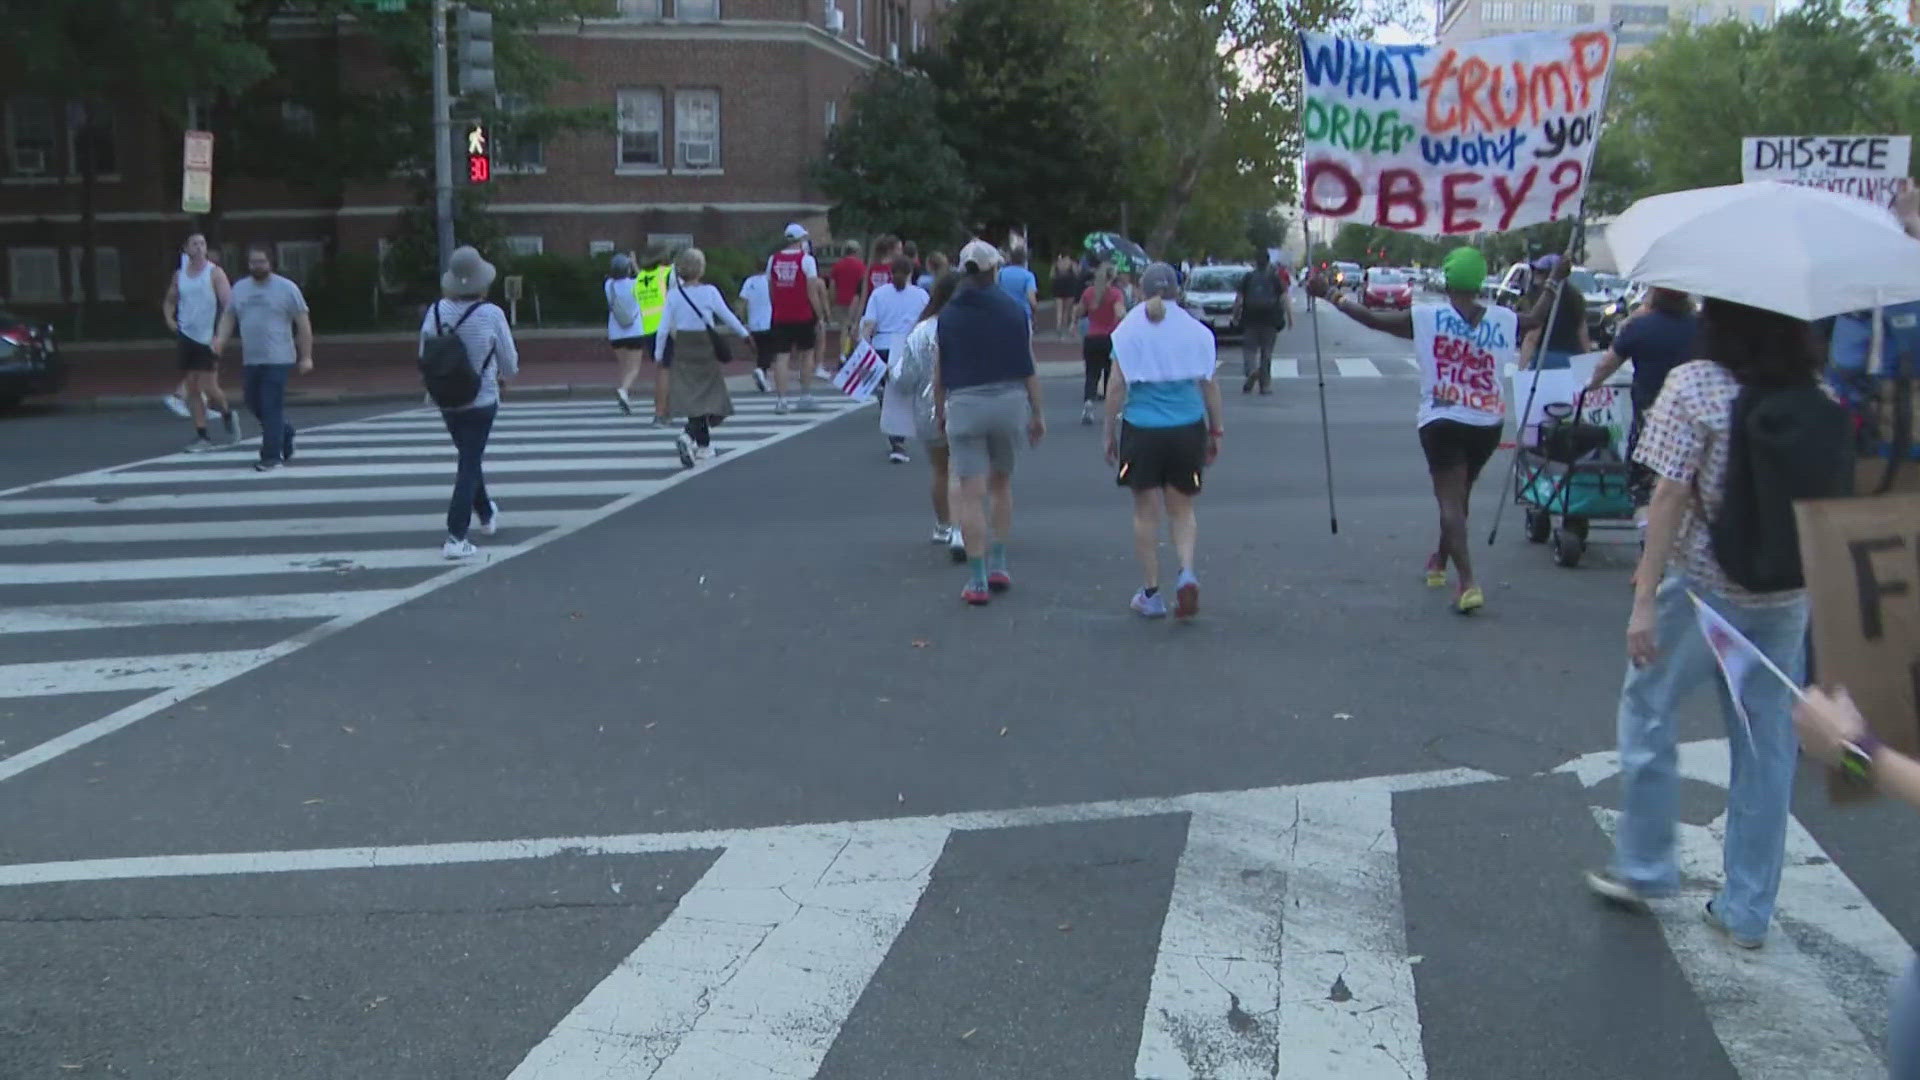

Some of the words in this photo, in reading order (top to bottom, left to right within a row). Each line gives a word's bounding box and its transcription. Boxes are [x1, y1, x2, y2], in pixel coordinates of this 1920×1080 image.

[1300, 33, 1430, 101] WHAT
[469, 156, 489, 182] 30
[1755, 137, 1890, 171] DHS+ICE
[1304, 158, 1583, 235] OBEY?
[1435, 308, 1477, 340] FREE
